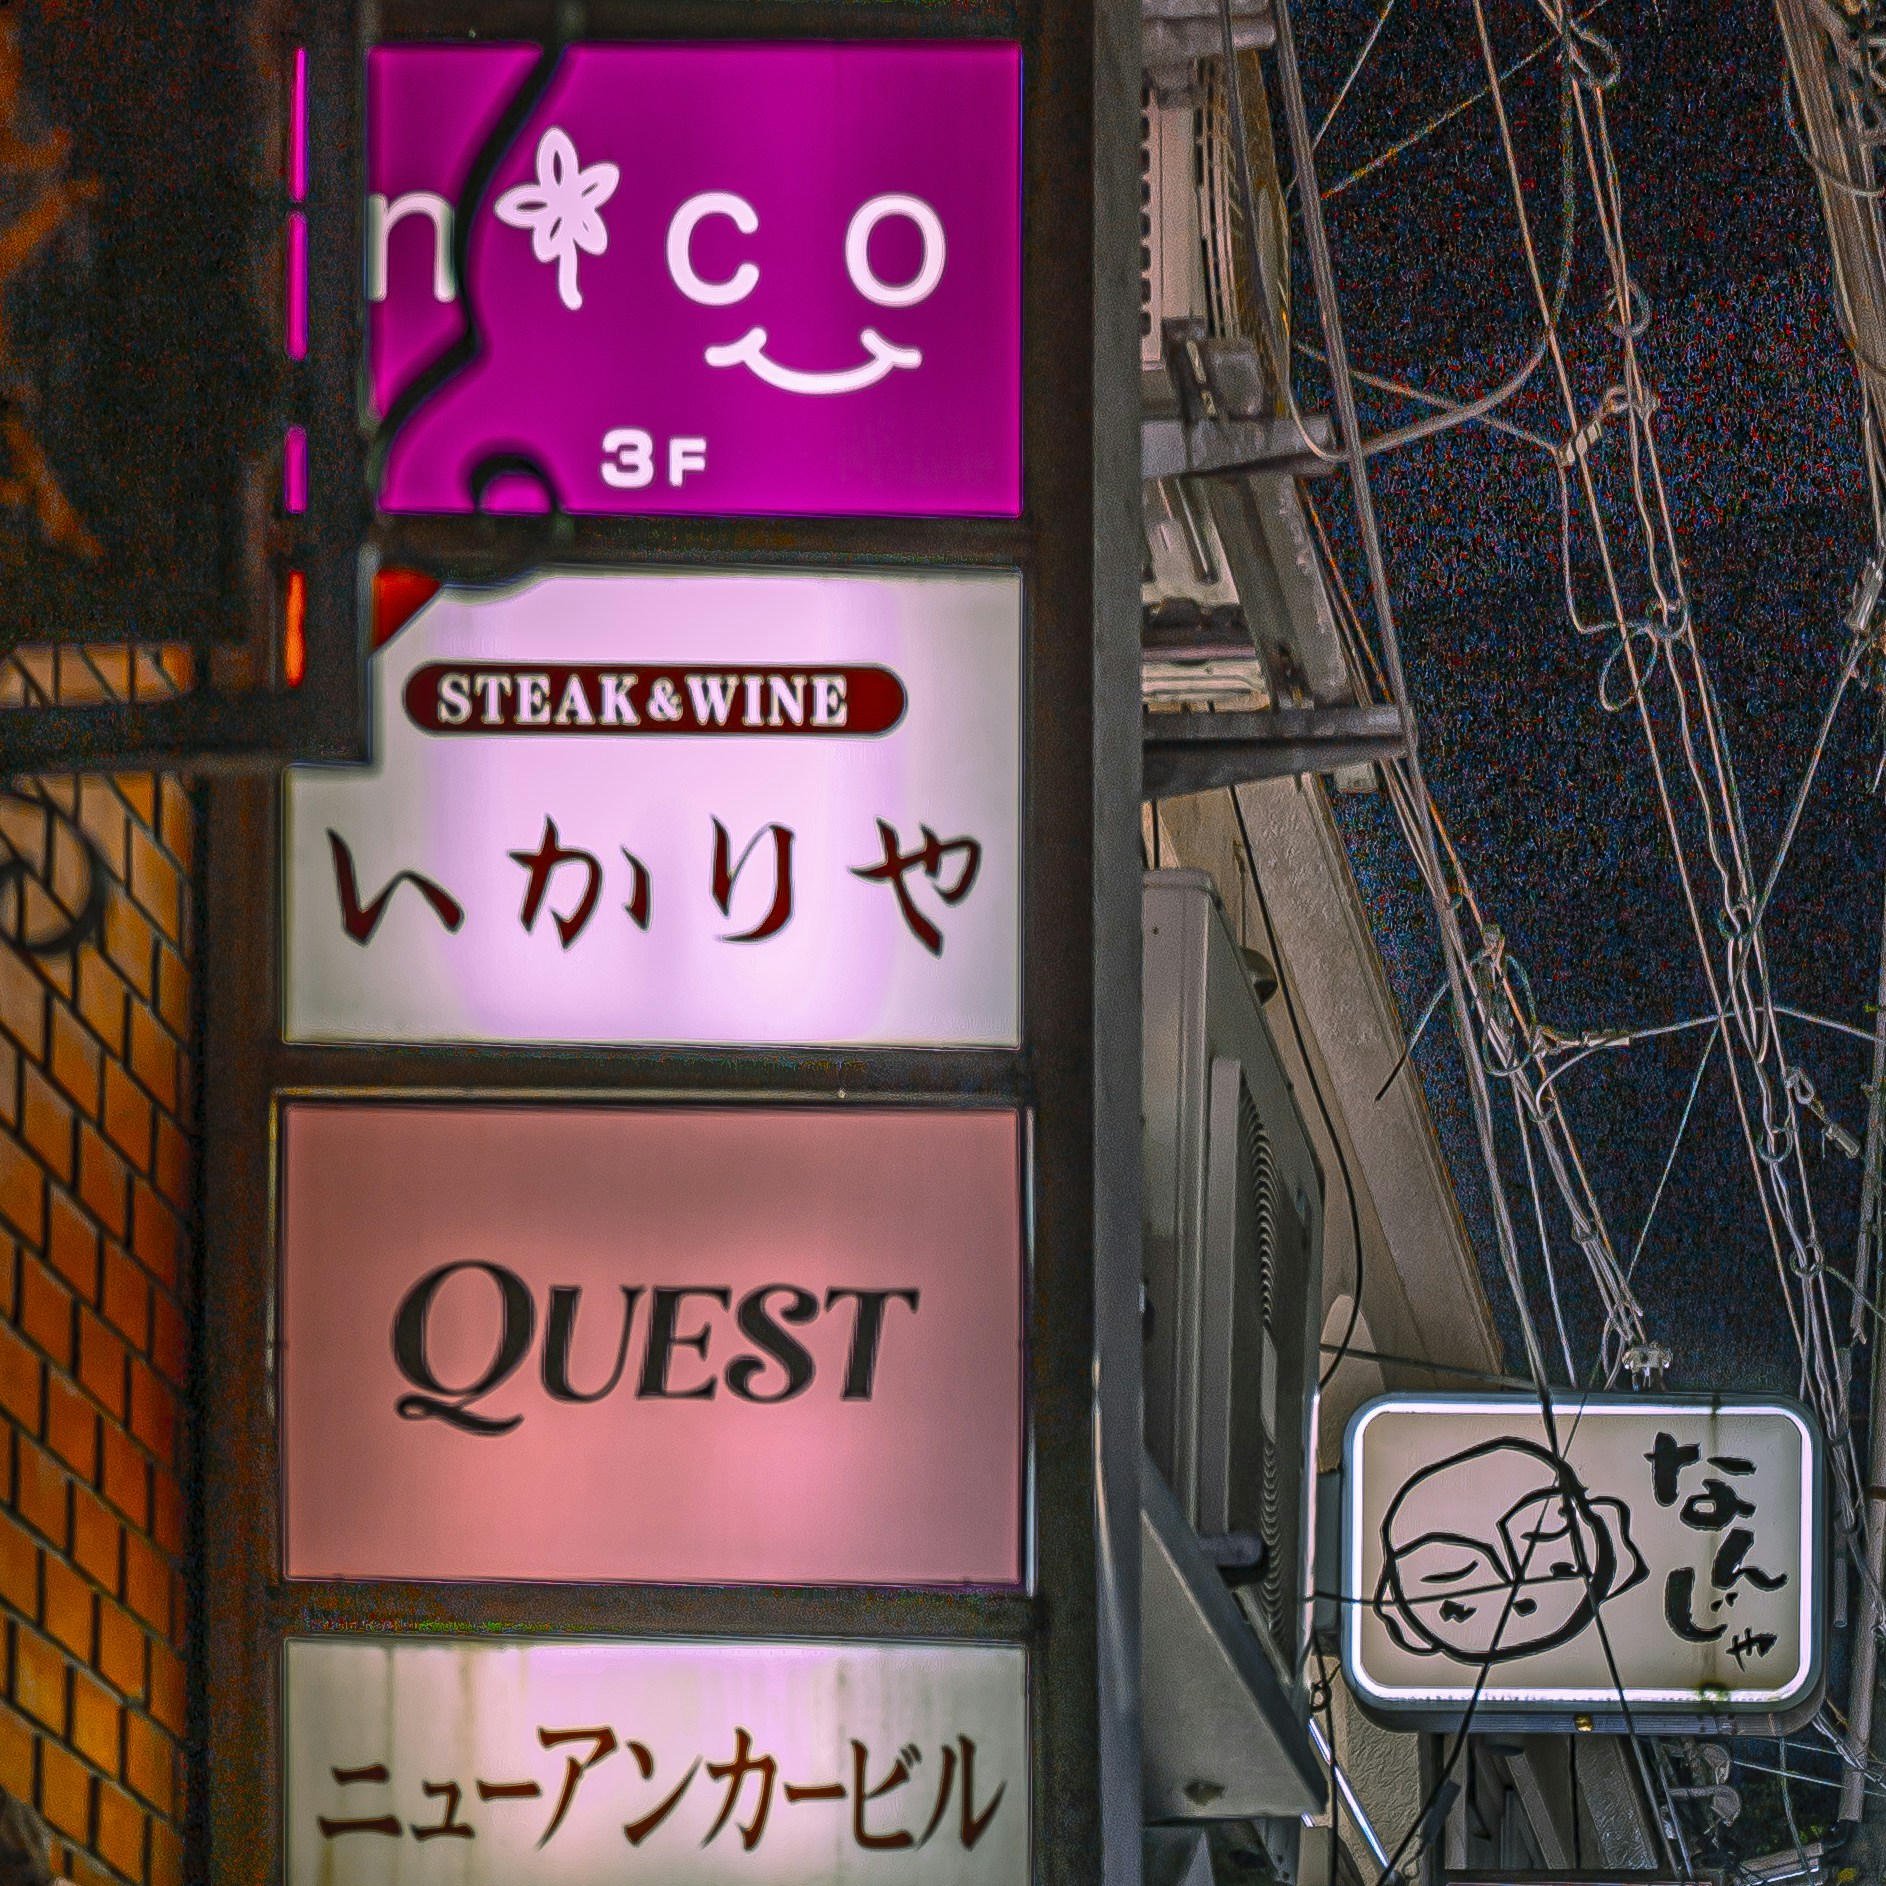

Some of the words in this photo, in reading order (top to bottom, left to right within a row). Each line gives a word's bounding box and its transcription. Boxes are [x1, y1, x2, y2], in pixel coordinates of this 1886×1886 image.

[601, 429, 707, 488] 3F
[437, 674, 851, 728] STEAK&WINE
[325, 813, 982, 958] いかりや
[389, 1259, 920, 1437] QUEST
[316, 1724, 1006, 1853] ニューアンカービル
